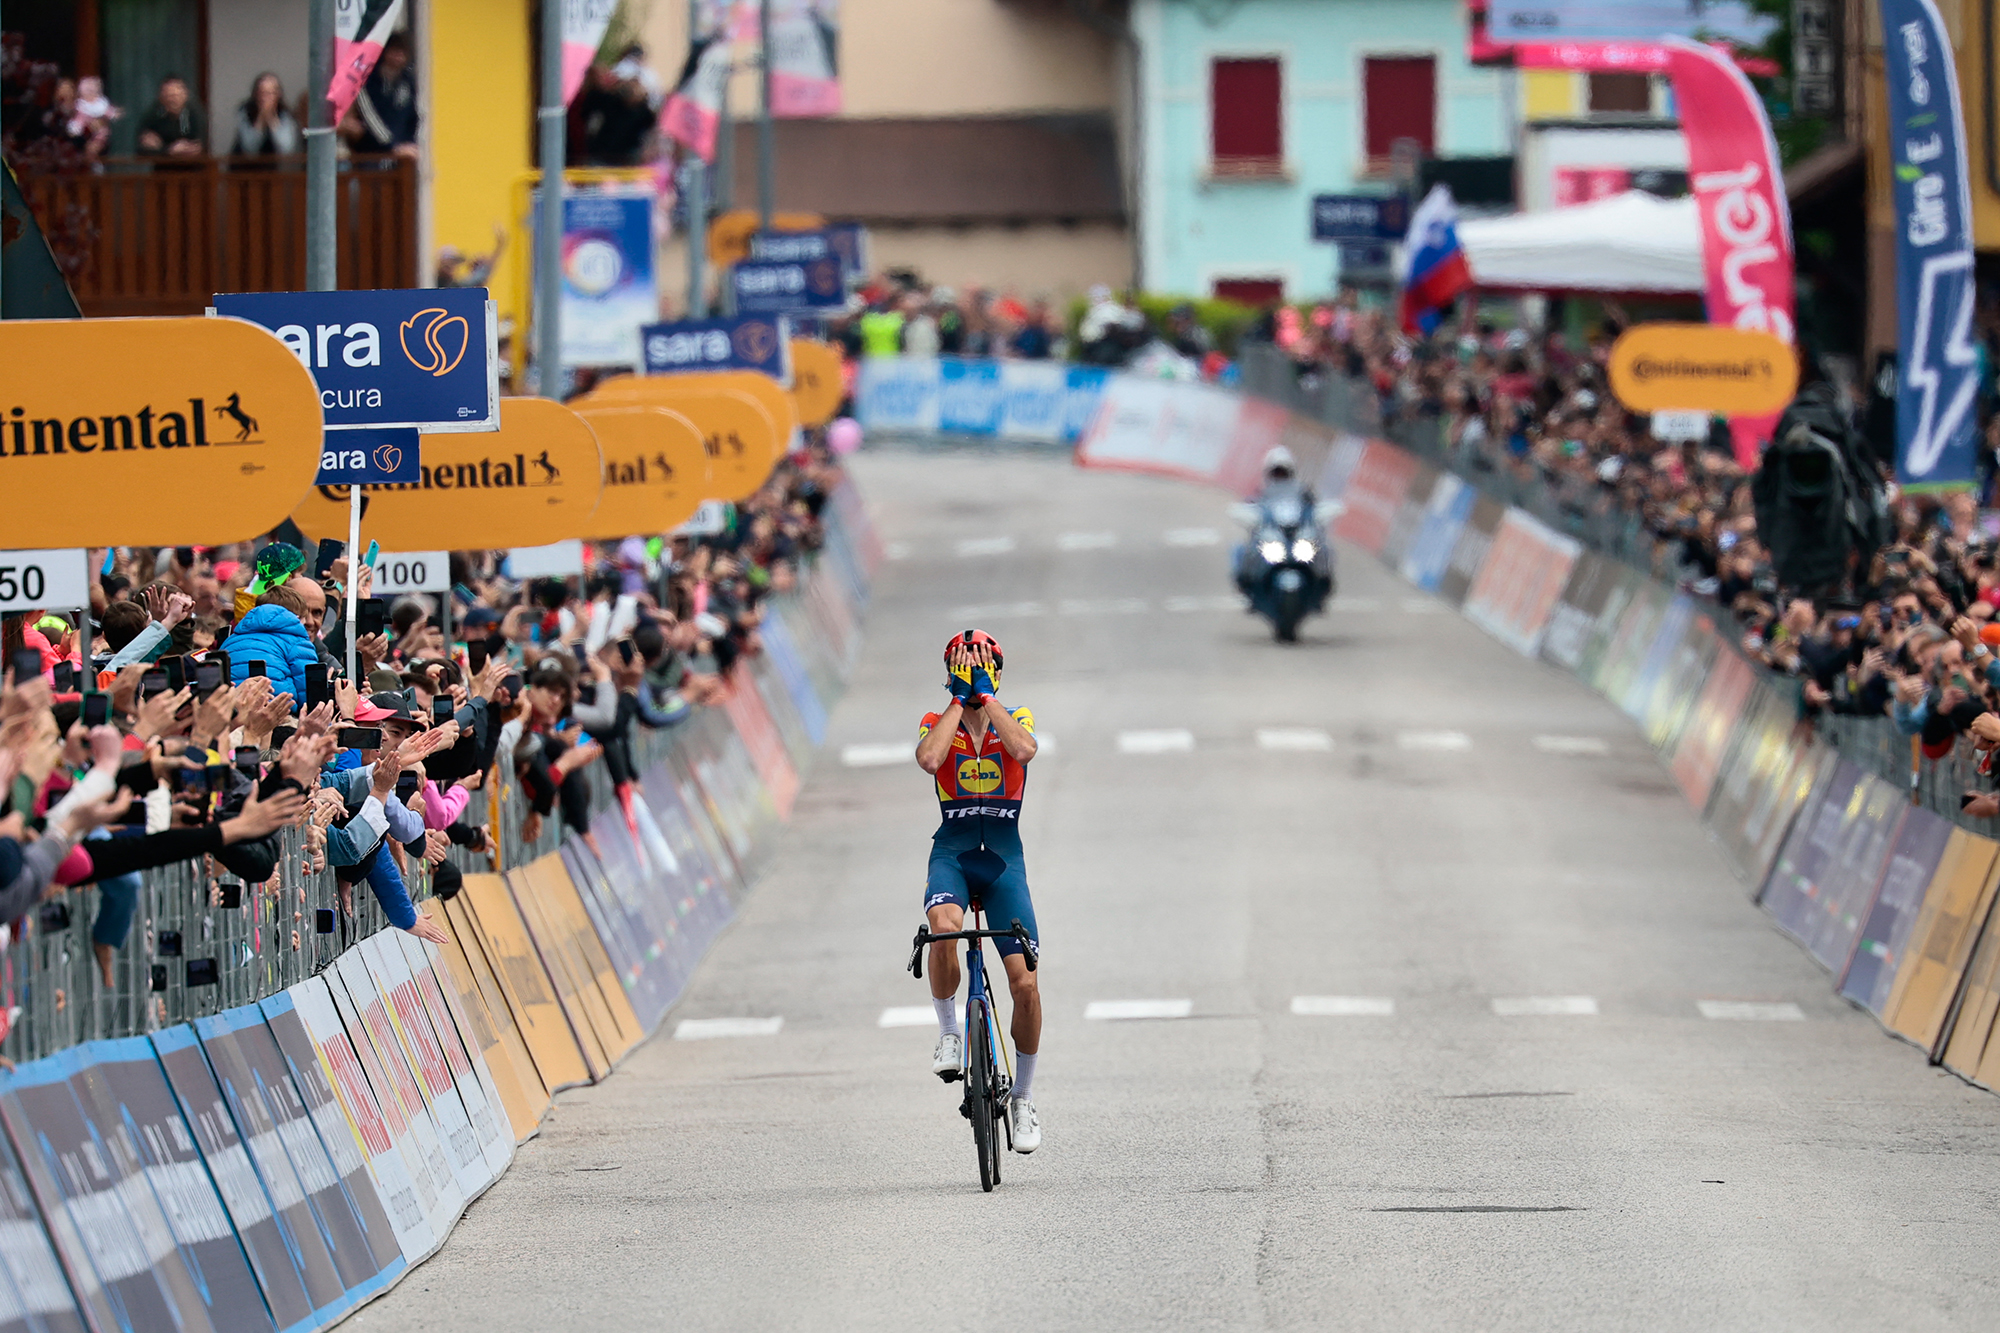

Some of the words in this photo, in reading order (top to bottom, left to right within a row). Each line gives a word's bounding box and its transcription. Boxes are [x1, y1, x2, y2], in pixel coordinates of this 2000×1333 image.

[648, 330, 732, 366] sara
[0, 564, 45, 602] 50
[376, 561, 426, 586] 100
[945, 806, 1017, 819] TREK
